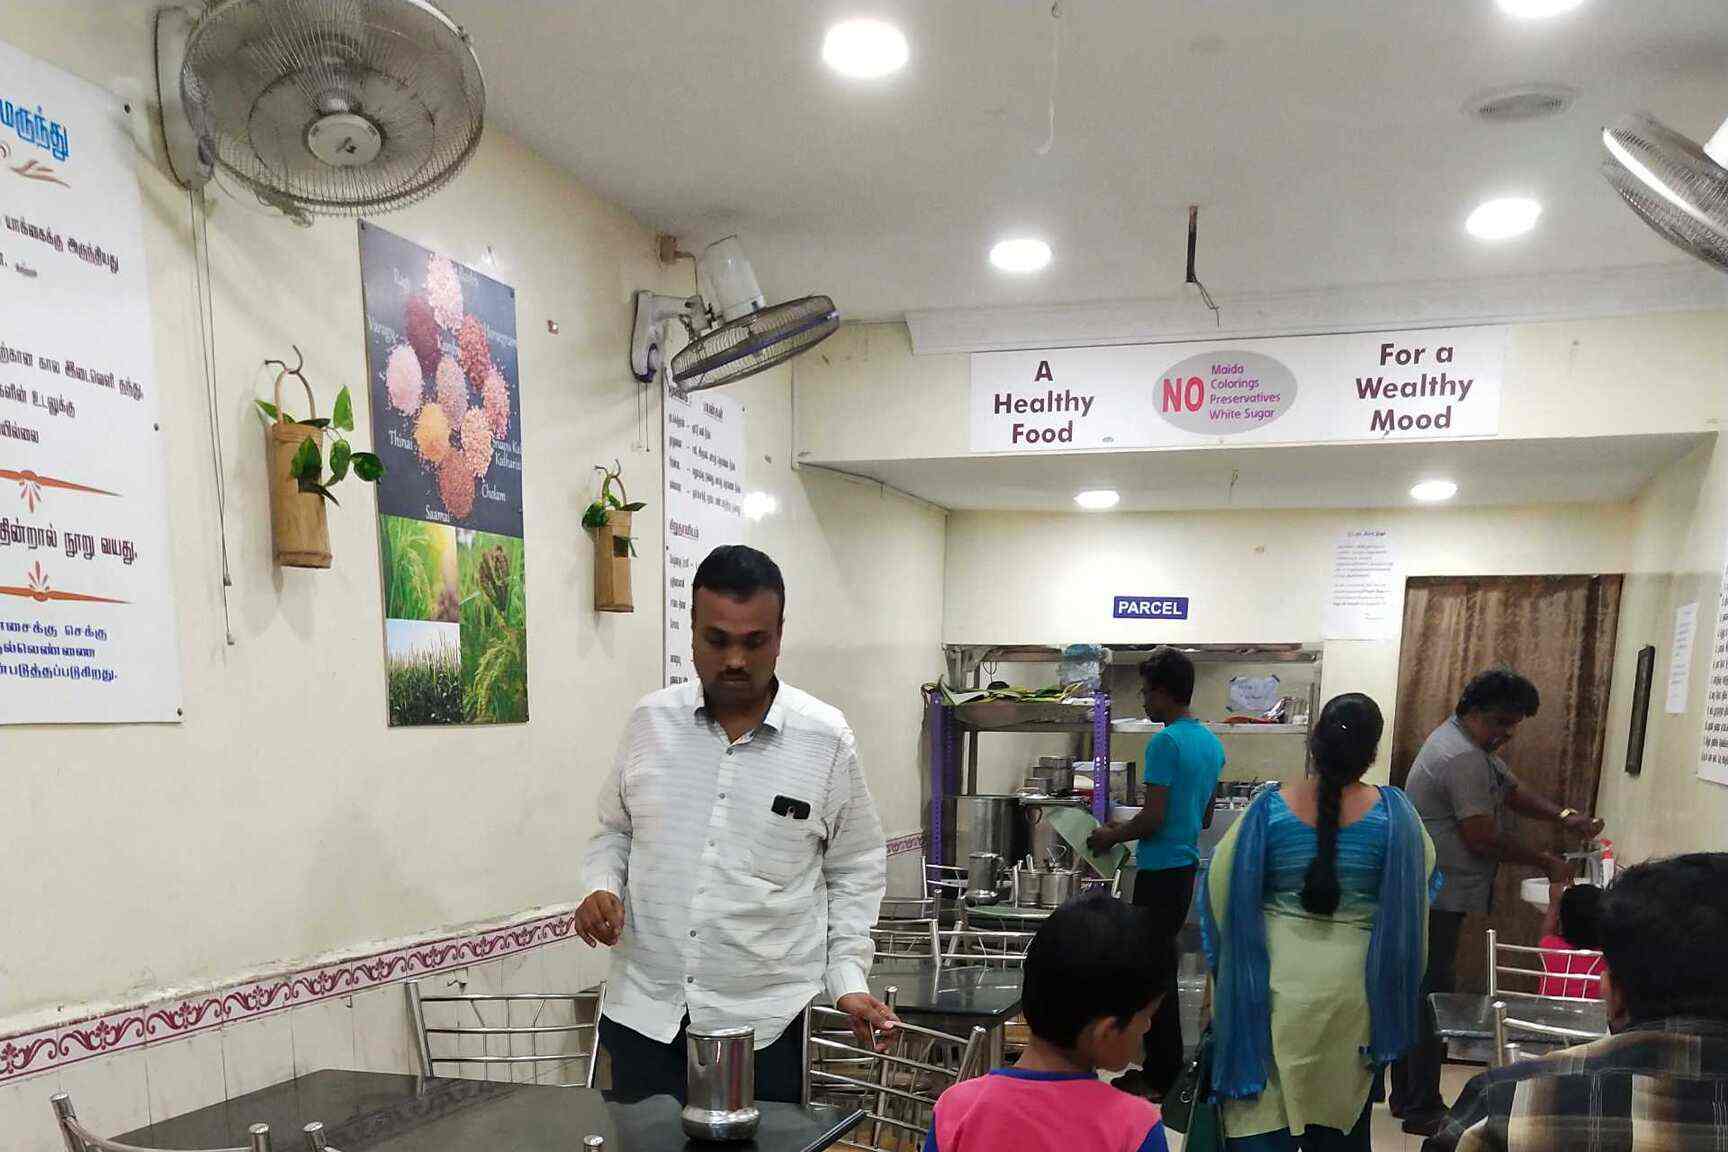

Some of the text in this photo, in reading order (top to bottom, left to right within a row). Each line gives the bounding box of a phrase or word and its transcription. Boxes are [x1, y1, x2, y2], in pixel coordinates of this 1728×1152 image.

[1379, 343, 1454, 366] For a
[1034, 360, 1053, 382] A
[1211, 364, 1244, 375] Maida
[1161, 376, 1204, 413] NO
[1210, 379, 1259, 391] Colorings
[1355, 373, 1474, 401] Wealthy
[993, 390, 1095, 416] Healthy
[1210, 392, 1280, 405] Preservatives
[1209, 408, 1275, 421] White Sugar
[1370, 405, 1452, 431] Mood
[1012, 421, 1073, 444] Food
[65, 531, 95, 560] நூறு
[1118, 601, 1182, 615] PARCEL
